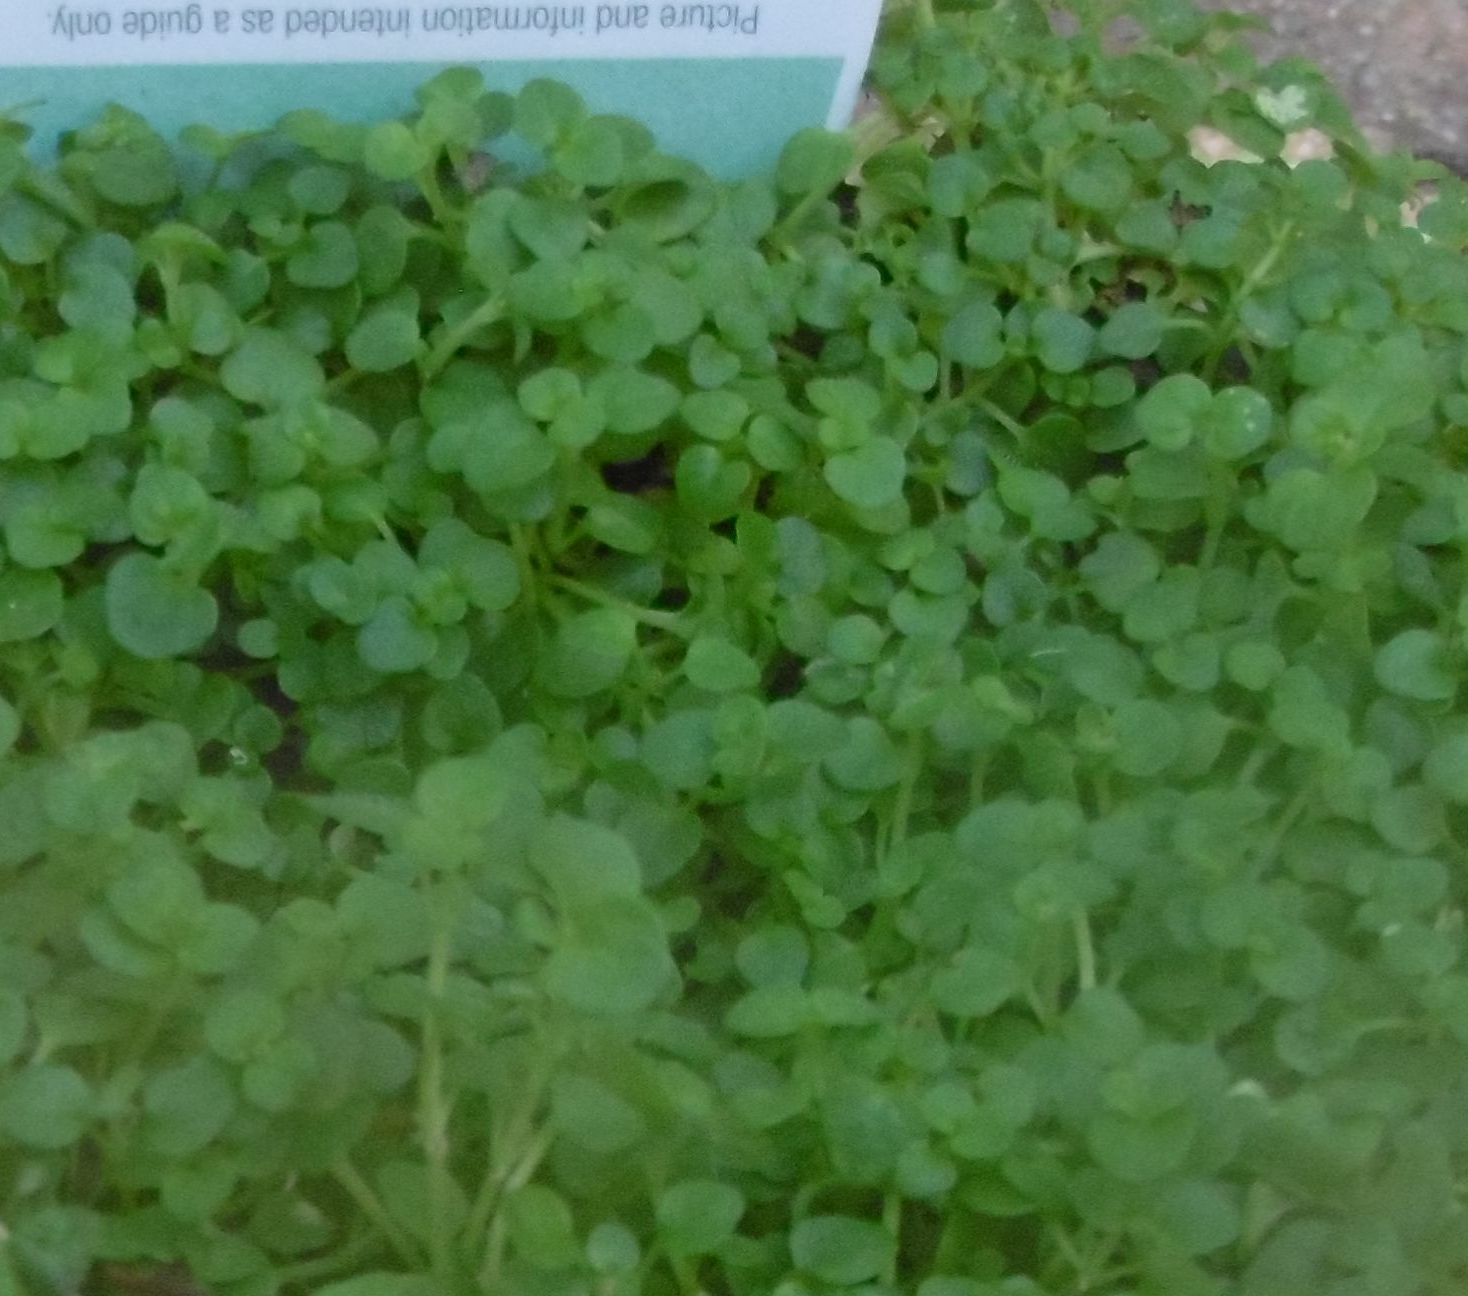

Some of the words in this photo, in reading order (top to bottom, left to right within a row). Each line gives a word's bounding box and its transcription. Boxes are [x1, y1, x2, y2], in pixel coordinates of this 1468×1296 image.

[47, 6, 113, 40] only.
[121, 4, 204, 39] guide
[212, 10, 231, 32] a
[240, 9, 275, 32] as
[284, 7, 411, 38] intended
[421, 5, 585, 36] information
[595, 3, 649, 33] and
[658, 3, 760, 34] Picture
